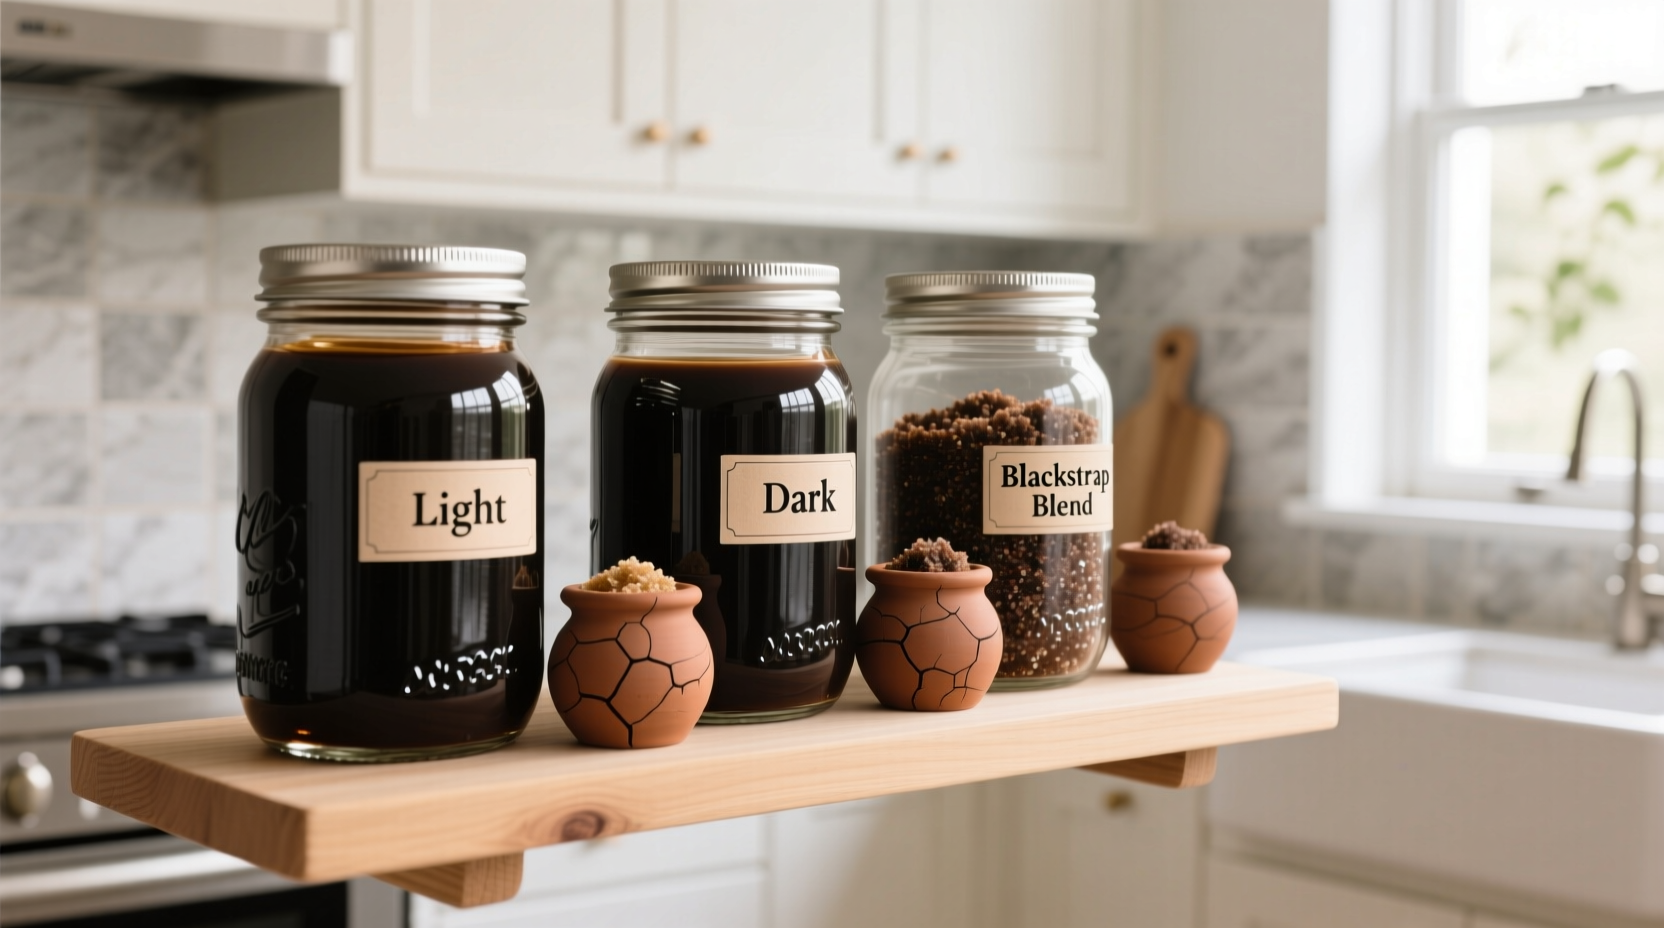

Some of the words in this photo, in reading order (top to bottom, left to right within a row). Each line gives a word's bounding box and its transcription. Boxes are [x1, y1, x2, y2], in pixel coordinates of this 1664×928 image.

[1001, 462, 1110, 493] Blackstrap
[412, 488, 506, 538] Light
[763, 478, 836, 515] Dark
[1032, 491, 1093, 518] Blend
